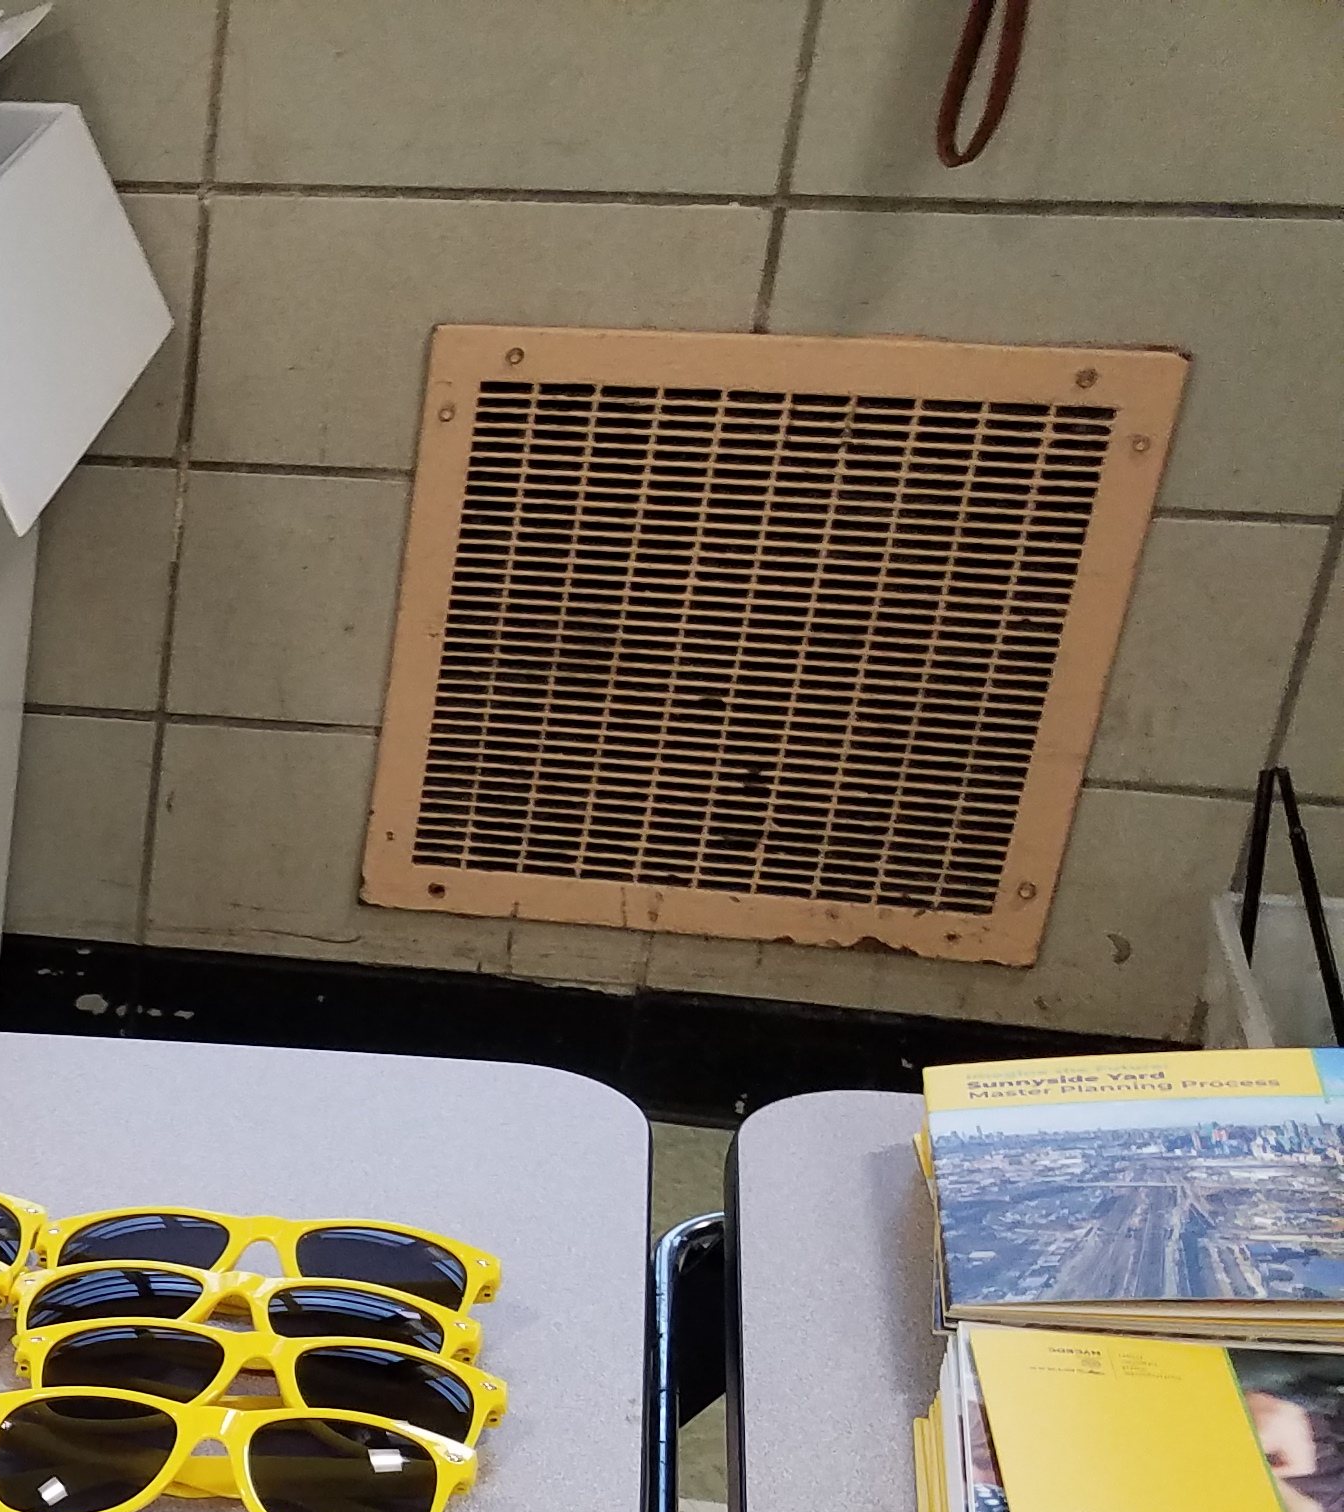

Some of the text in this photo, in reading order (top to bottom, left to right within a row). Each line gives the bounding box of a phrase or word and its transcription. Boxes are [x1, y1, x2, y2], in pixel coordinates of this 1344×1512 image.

[966, 1071, 1166, 1091] Sunnyside Yard
[968, 1078, 1281, 1100] Master Planning Process
